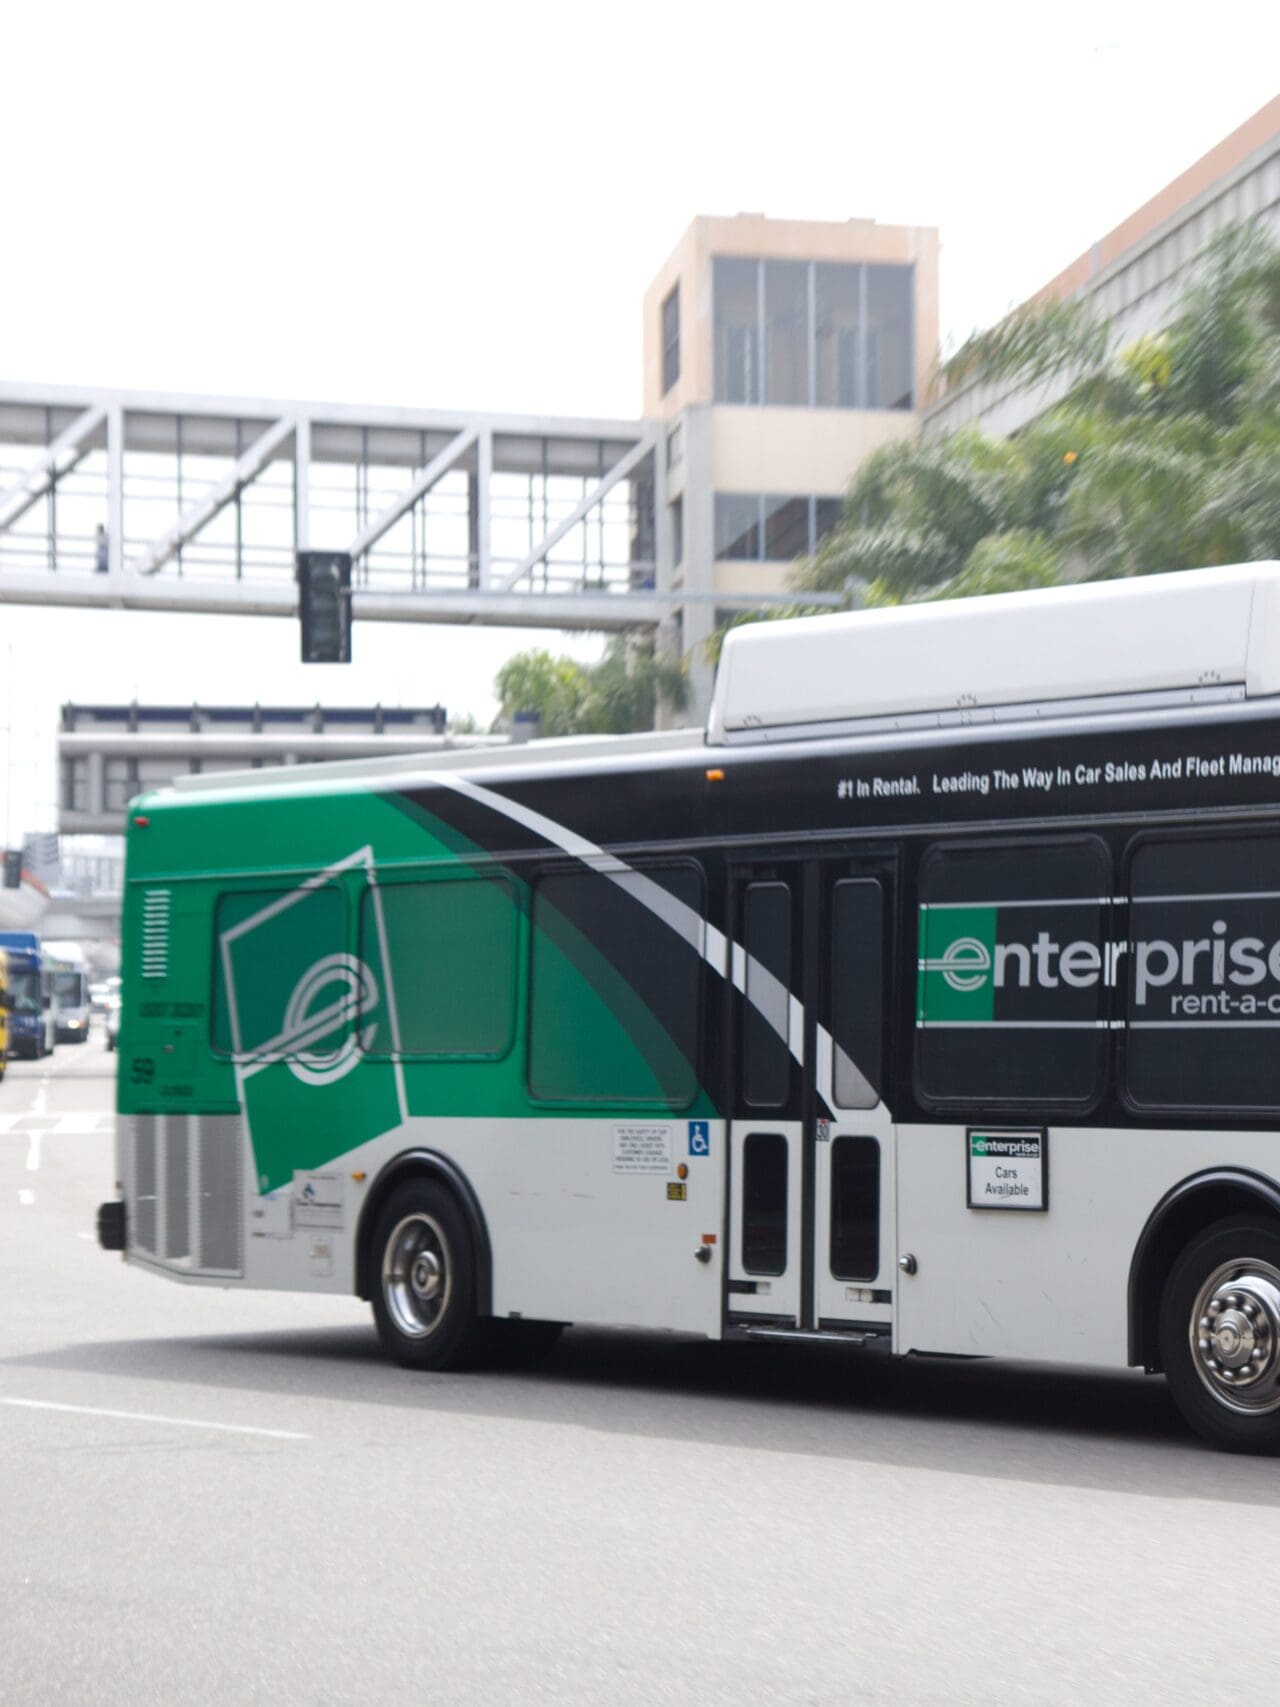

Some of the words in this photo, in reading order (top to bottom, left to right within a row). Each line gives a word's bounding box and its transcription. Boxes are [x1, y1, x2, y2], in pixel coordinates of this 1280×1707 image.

[837, 780, 853, 799] #1
[856, 779, 870, 797] In
[873, 775, 921, 797] Rental.
[932, 771, 989, 794] Leading
[993, 769, 1019, 790] The
[1022, 767, 1054, 791] Way
[1057, 766, 1071, 786] In
[1075, 764, 1101, 785] Car
[1104, 761, 1147, 783] Sales
[1150, 757, 1182, 779] And
[1186, 755, 1225, 777] Fleet
[975, 1140, 1039, 1155] enterprise
[995, 1166, 1018, 1179] Cars
[985, 1182, 1030, 1197] Available
